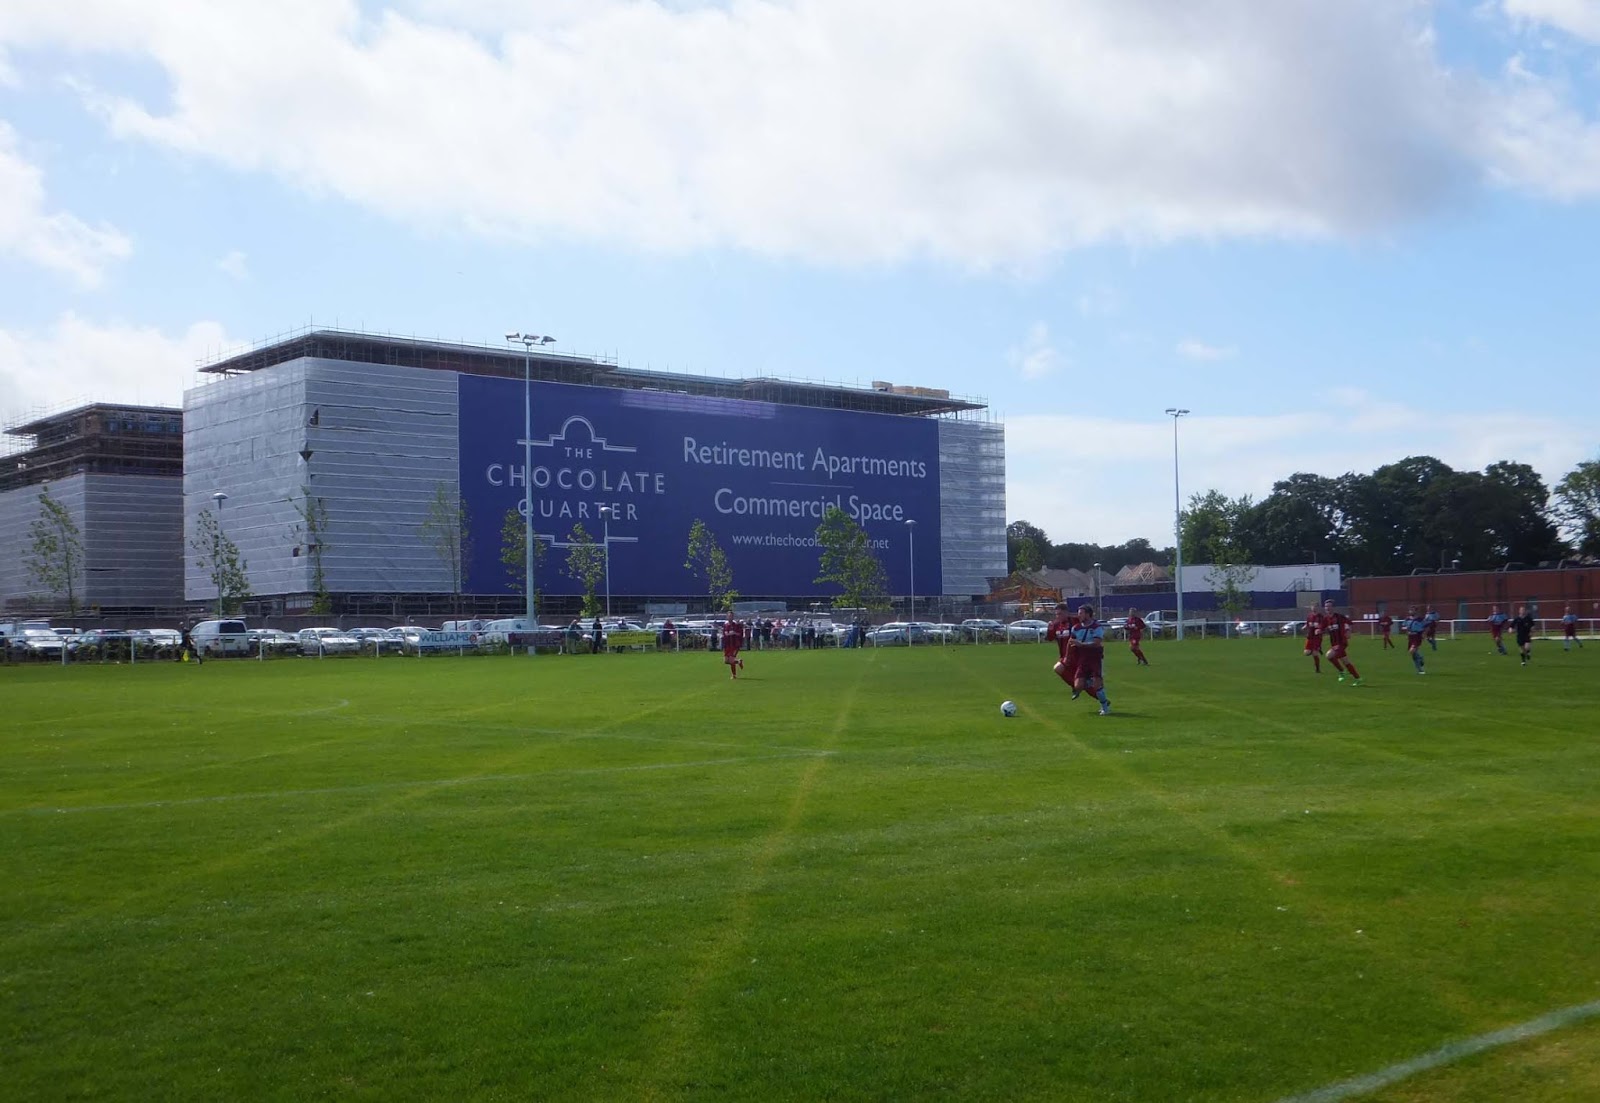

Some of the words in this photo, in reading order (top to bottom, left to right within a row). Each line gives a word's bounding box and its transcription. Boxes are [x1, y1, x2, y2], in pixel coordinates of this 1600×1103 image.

[565, 447, 593, 459] THE
[683, 436, 805, 470] Retirement
[812, 447, 927, 479] Apartments
[486, 463, 665, 494] CHOCOLATE
[517, 498, 638, 520] QUARTER
[849, 495, 904, 527] Space
